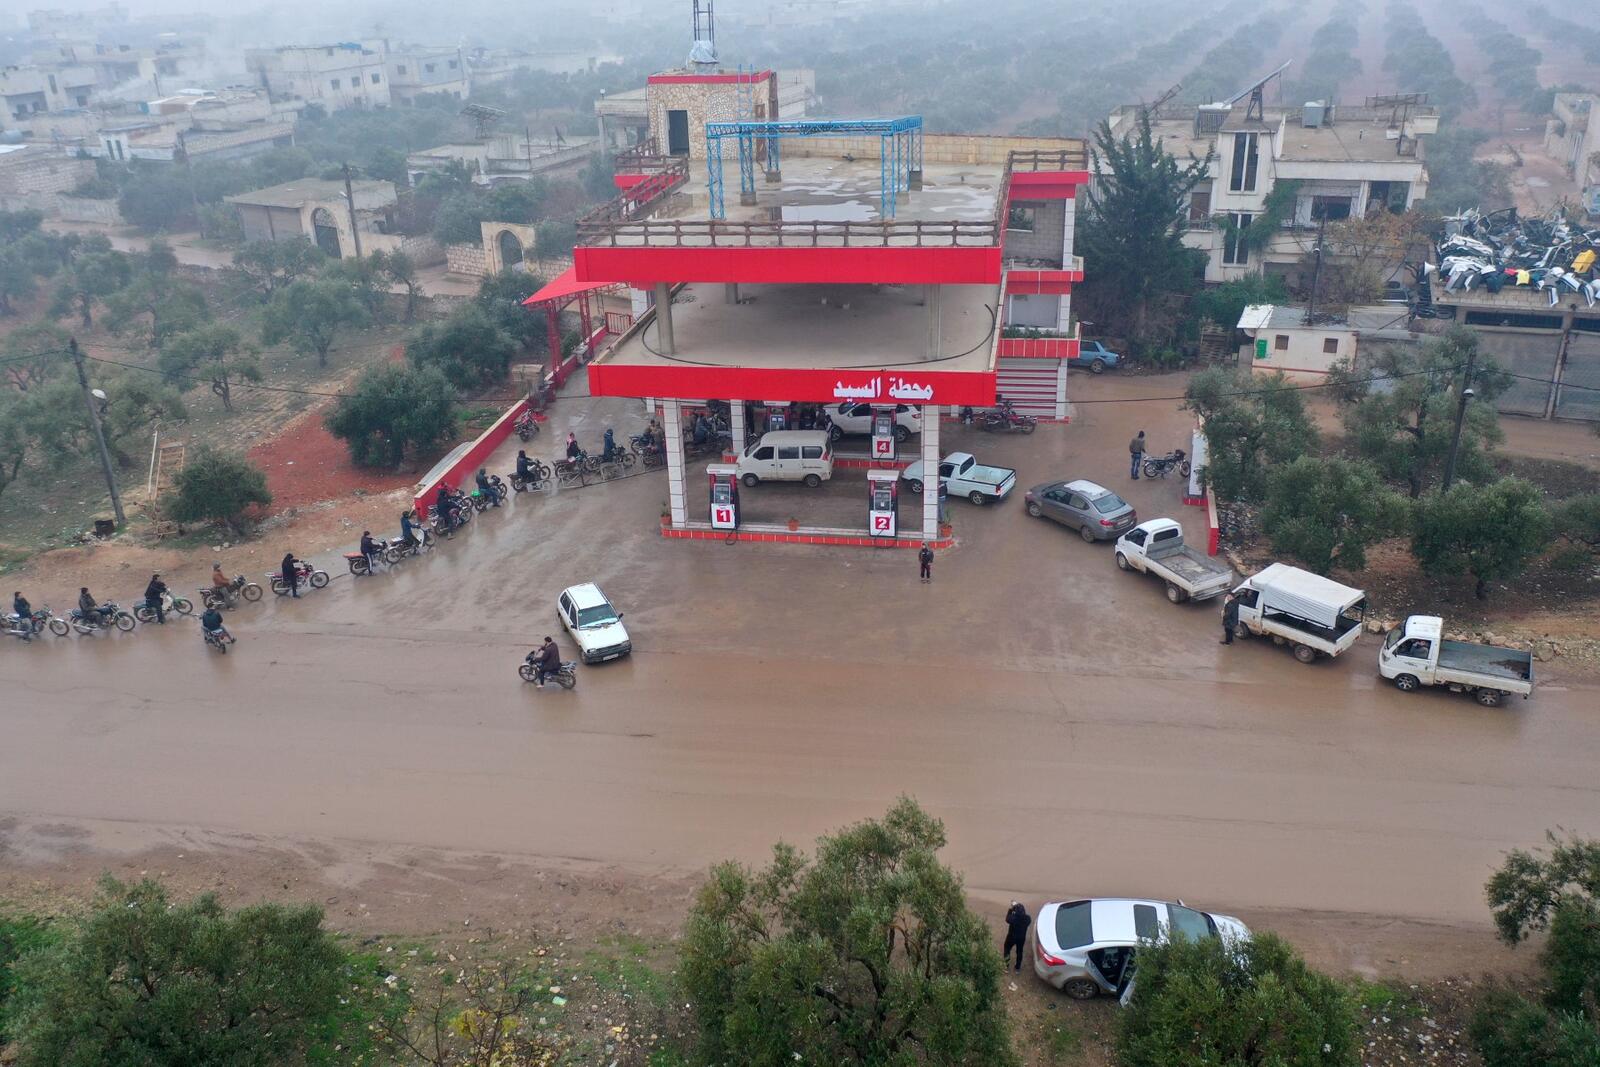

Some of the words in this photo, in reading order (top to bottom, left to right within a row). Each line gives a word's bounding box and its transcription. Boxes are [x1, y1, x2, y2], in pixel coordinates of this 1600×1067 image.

[833, 376, 881, 402] السيد
[888, 377, 934, 401] محطة
[879, 442, 889, 452] 4
[878, 518, 888, 529] 2
